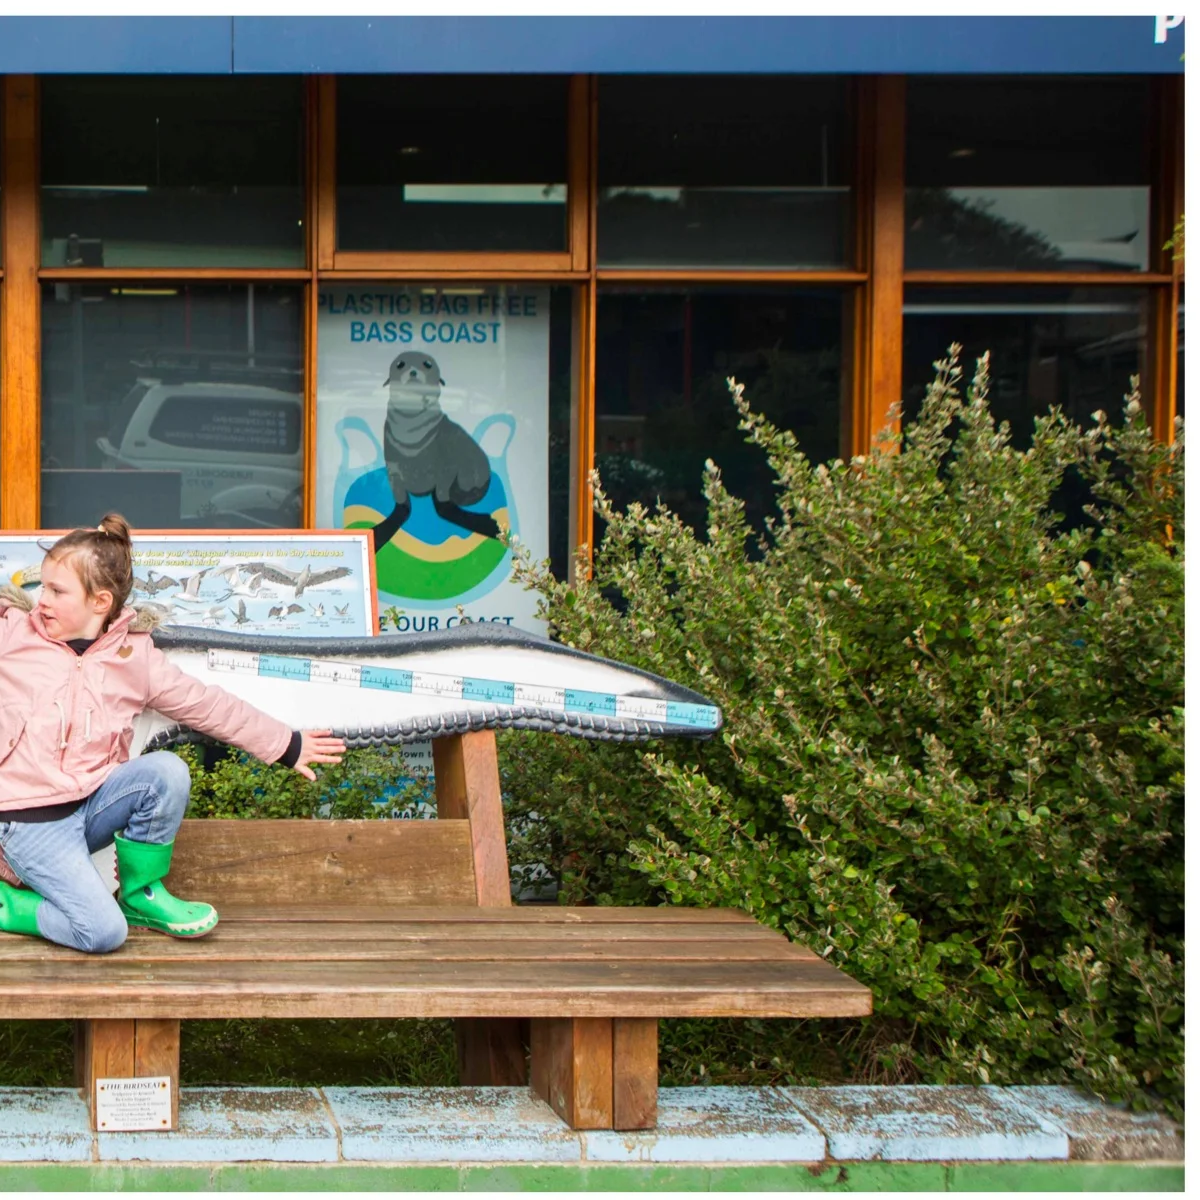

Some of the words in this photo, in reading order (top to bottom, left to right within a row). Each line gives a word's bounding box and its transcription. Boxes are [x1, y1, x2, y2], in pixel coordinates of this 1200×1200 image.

[419, 293, 470, 316] BAG
[477, 294, 538, 317] FREE
[351, 321, 413, 343] BASS
[421, 321, 501, 343] COAST
[166, 551, 185, 559] your
[229, 550, 264, 559] compare
[275, 549, 288, 557] the
[289, 549, 305, 558] Shy
[306, 549, 344, 557] Albatross
